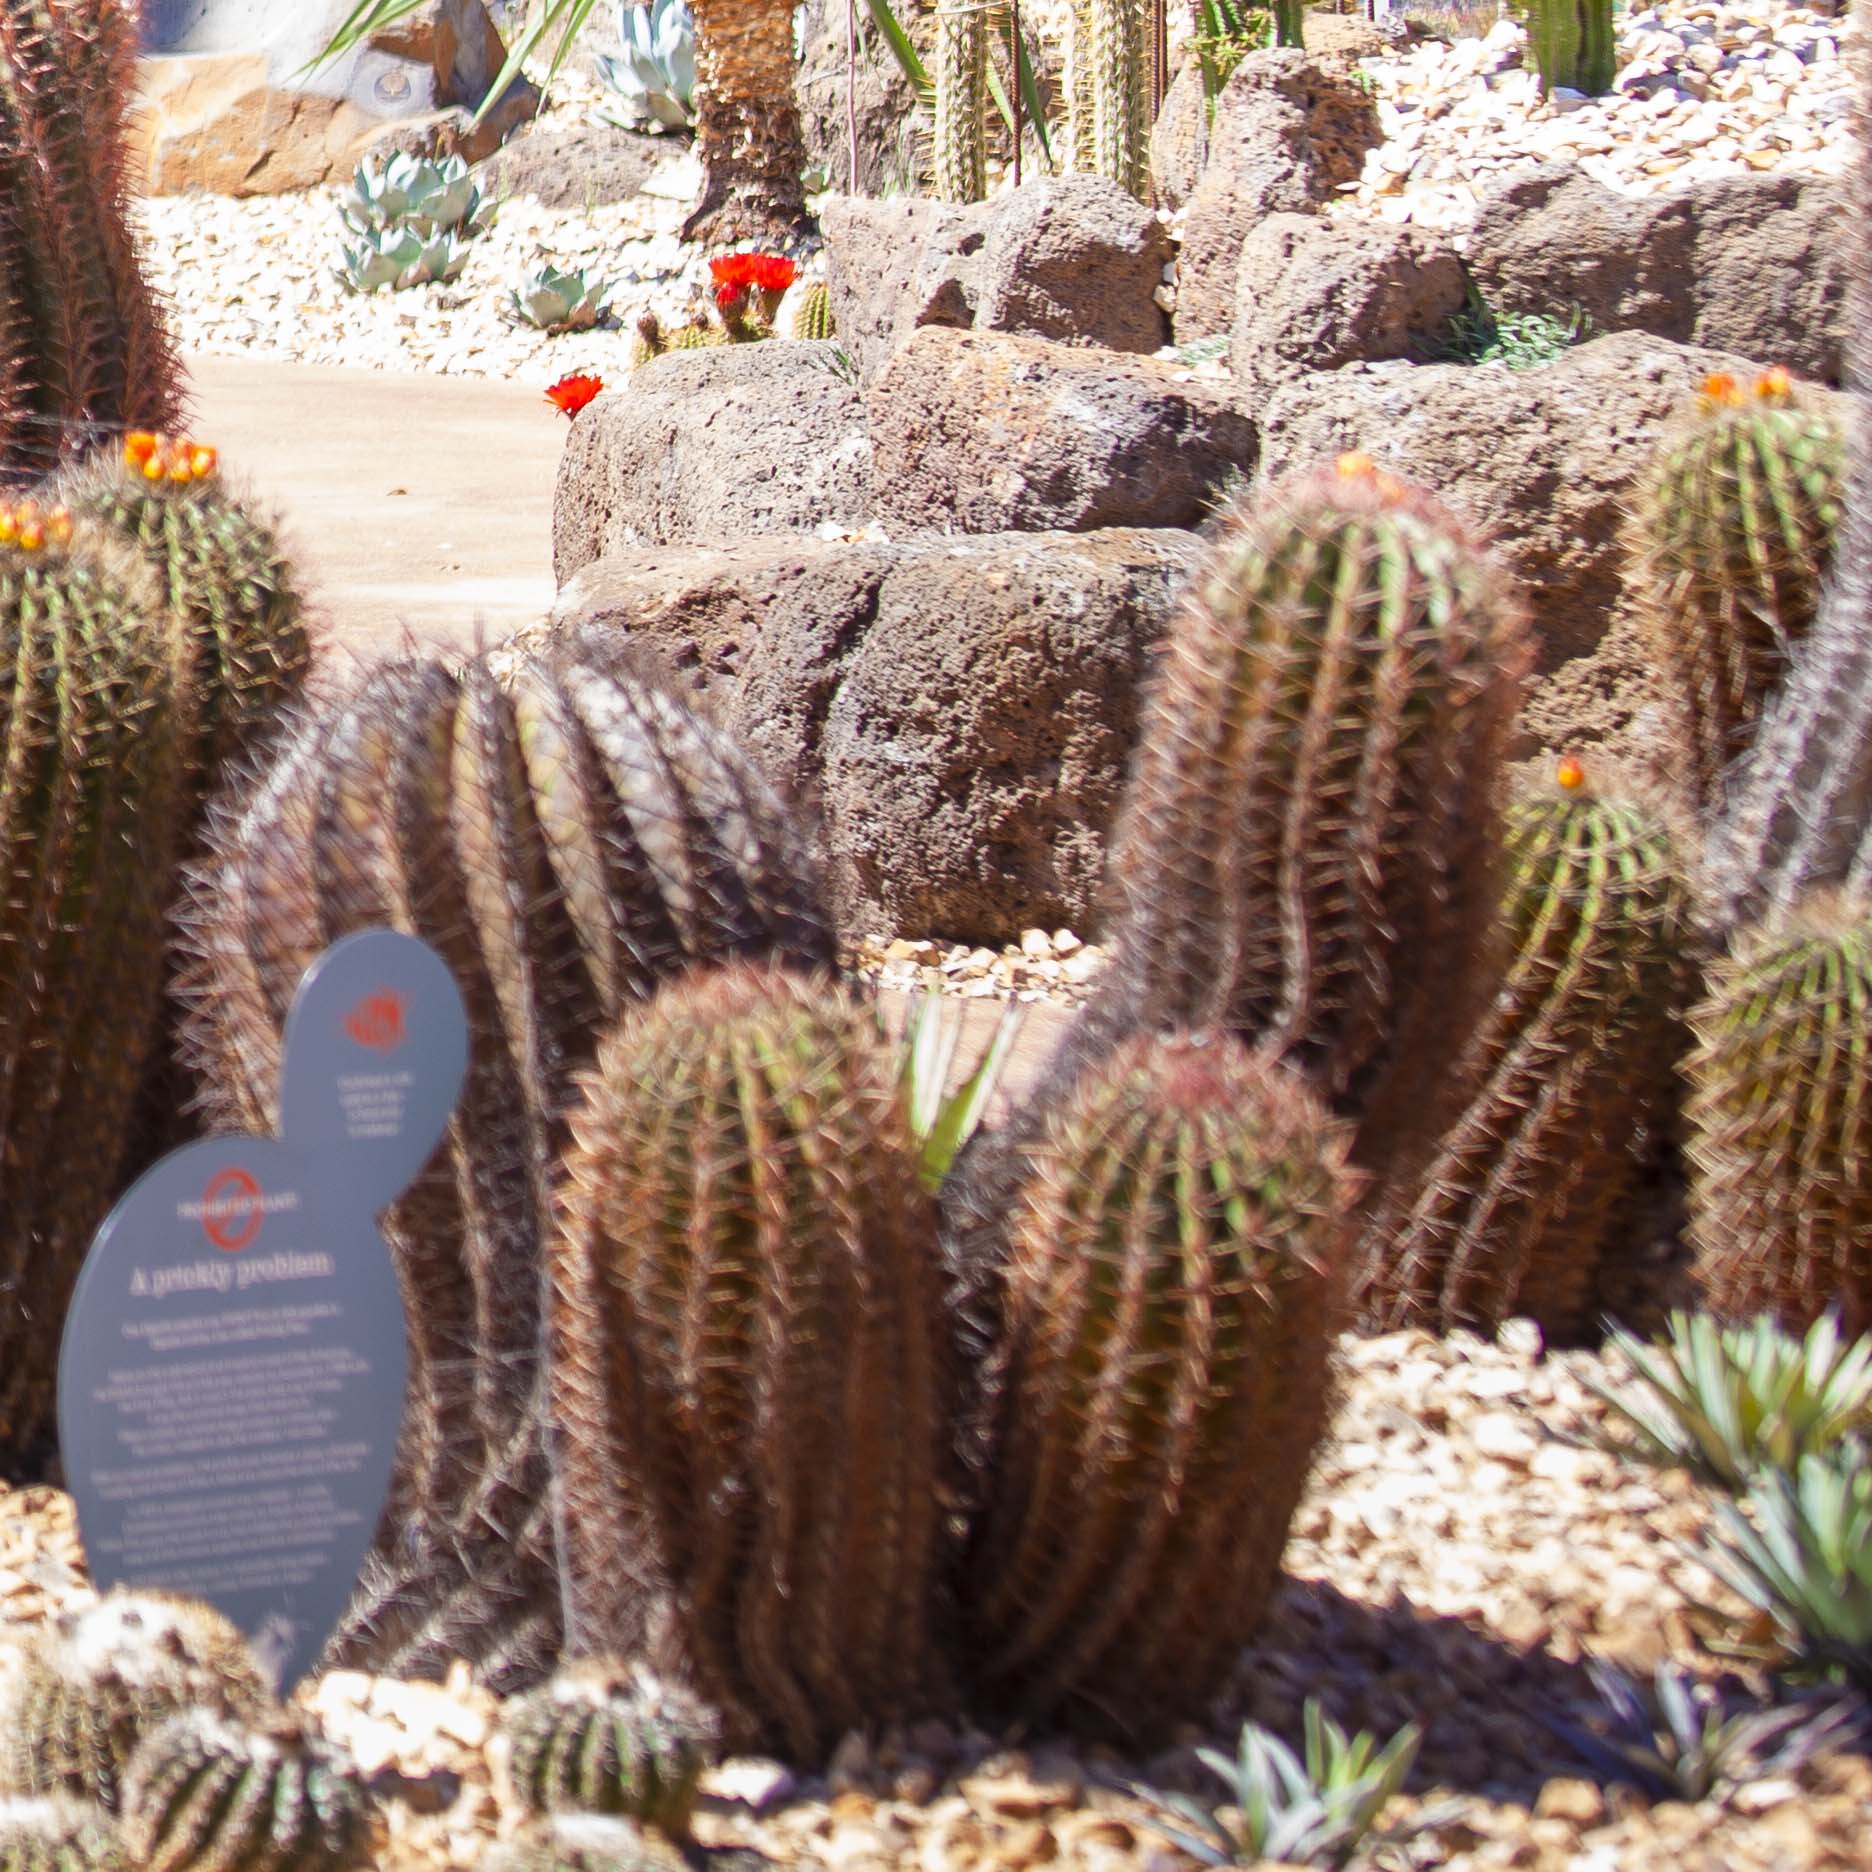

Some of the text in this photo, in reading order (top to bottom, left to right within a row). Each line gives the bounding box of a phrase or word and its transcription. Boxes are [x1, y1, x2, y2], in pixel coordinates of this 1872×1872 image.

[128, 1251, 336, 1299] A prickly problem
